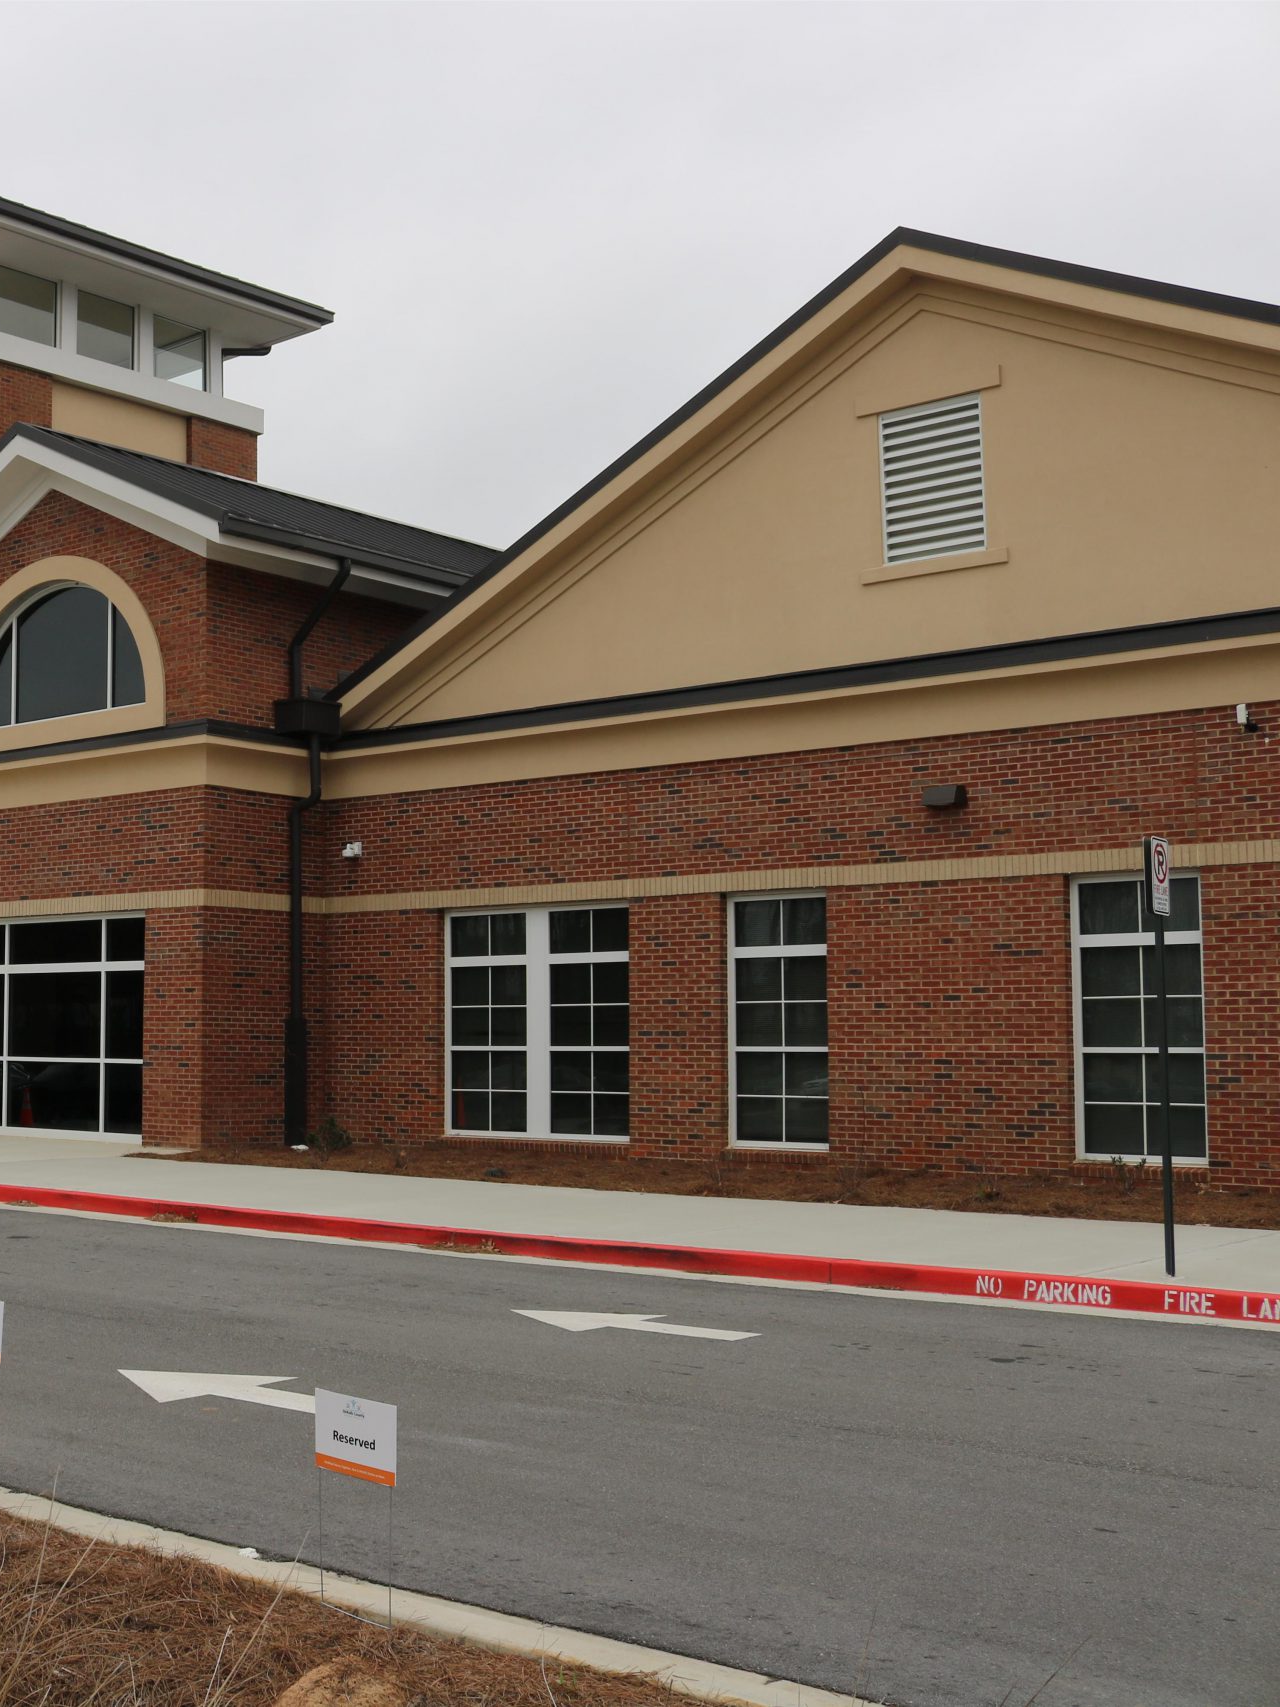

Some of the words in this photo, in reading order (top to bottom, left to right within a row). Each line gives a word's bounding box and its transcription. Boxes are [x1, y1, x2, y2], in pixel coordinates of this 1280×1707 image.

[975, 1275, 1002, 1296] NO
[1023, 1279, 1112, 1306] PARKING
[1164, 1290, 1216, 1315] FIRE
[333, 1430, 376, 1450] Reserved
